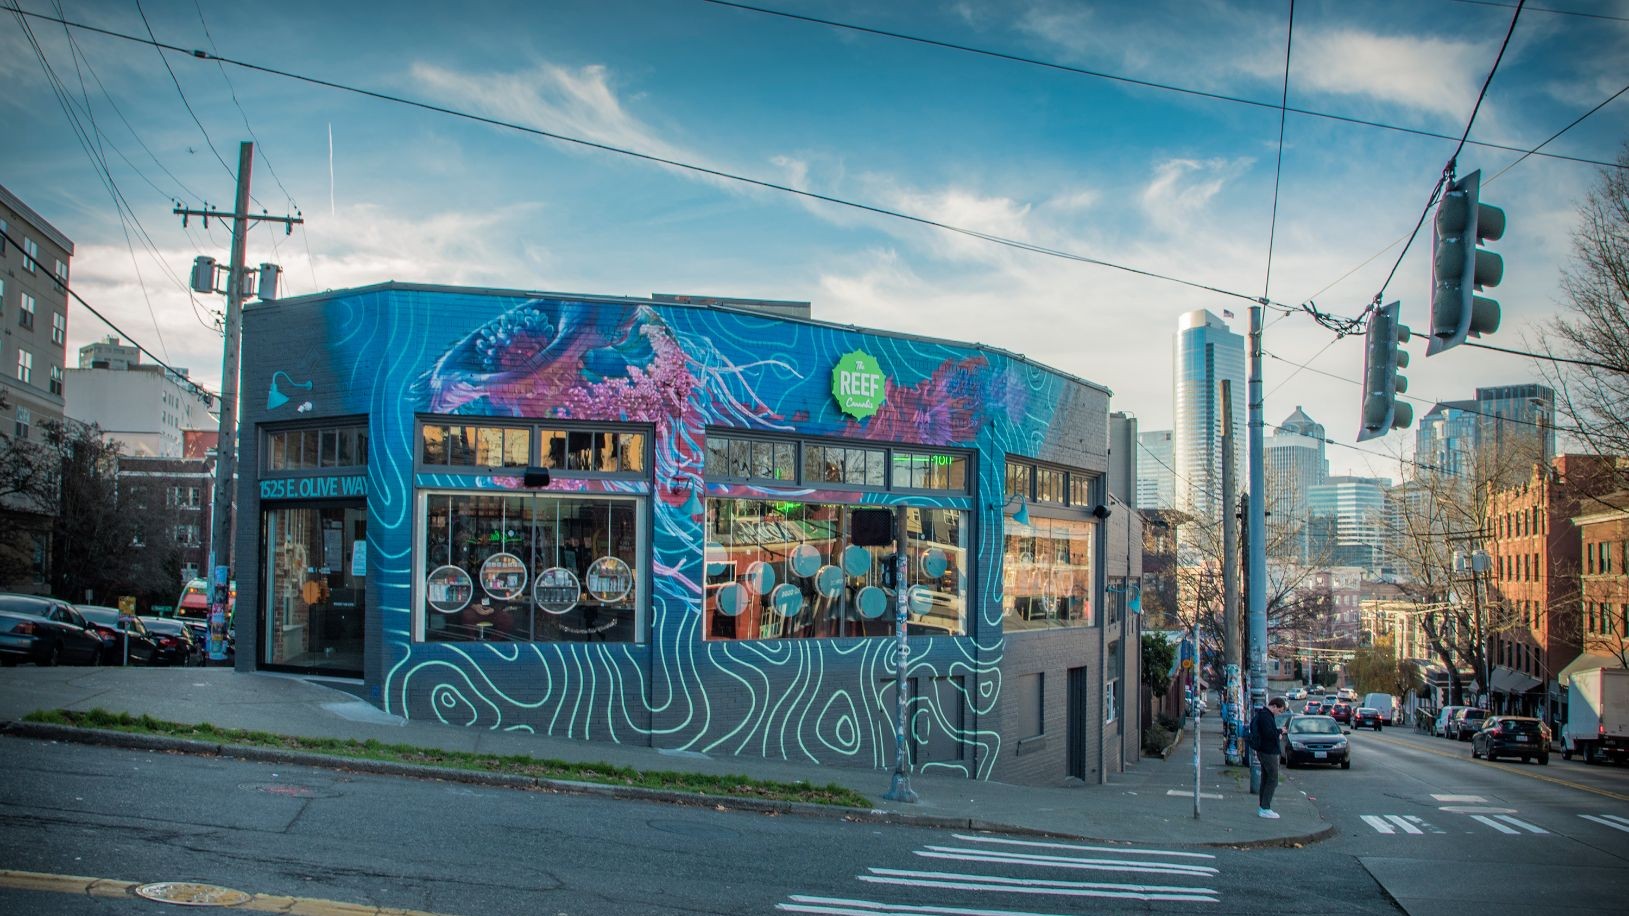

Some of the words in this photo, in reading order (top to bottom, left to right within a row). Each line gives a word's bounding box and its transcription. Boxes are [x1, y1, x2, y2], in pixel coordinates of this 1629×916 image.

[840, 370, 880, 398] REEF
[260, 480, 285, 498] 1525
[286, 479, 298, 497] E.
[300, 477, 338, 497] OLIVE
